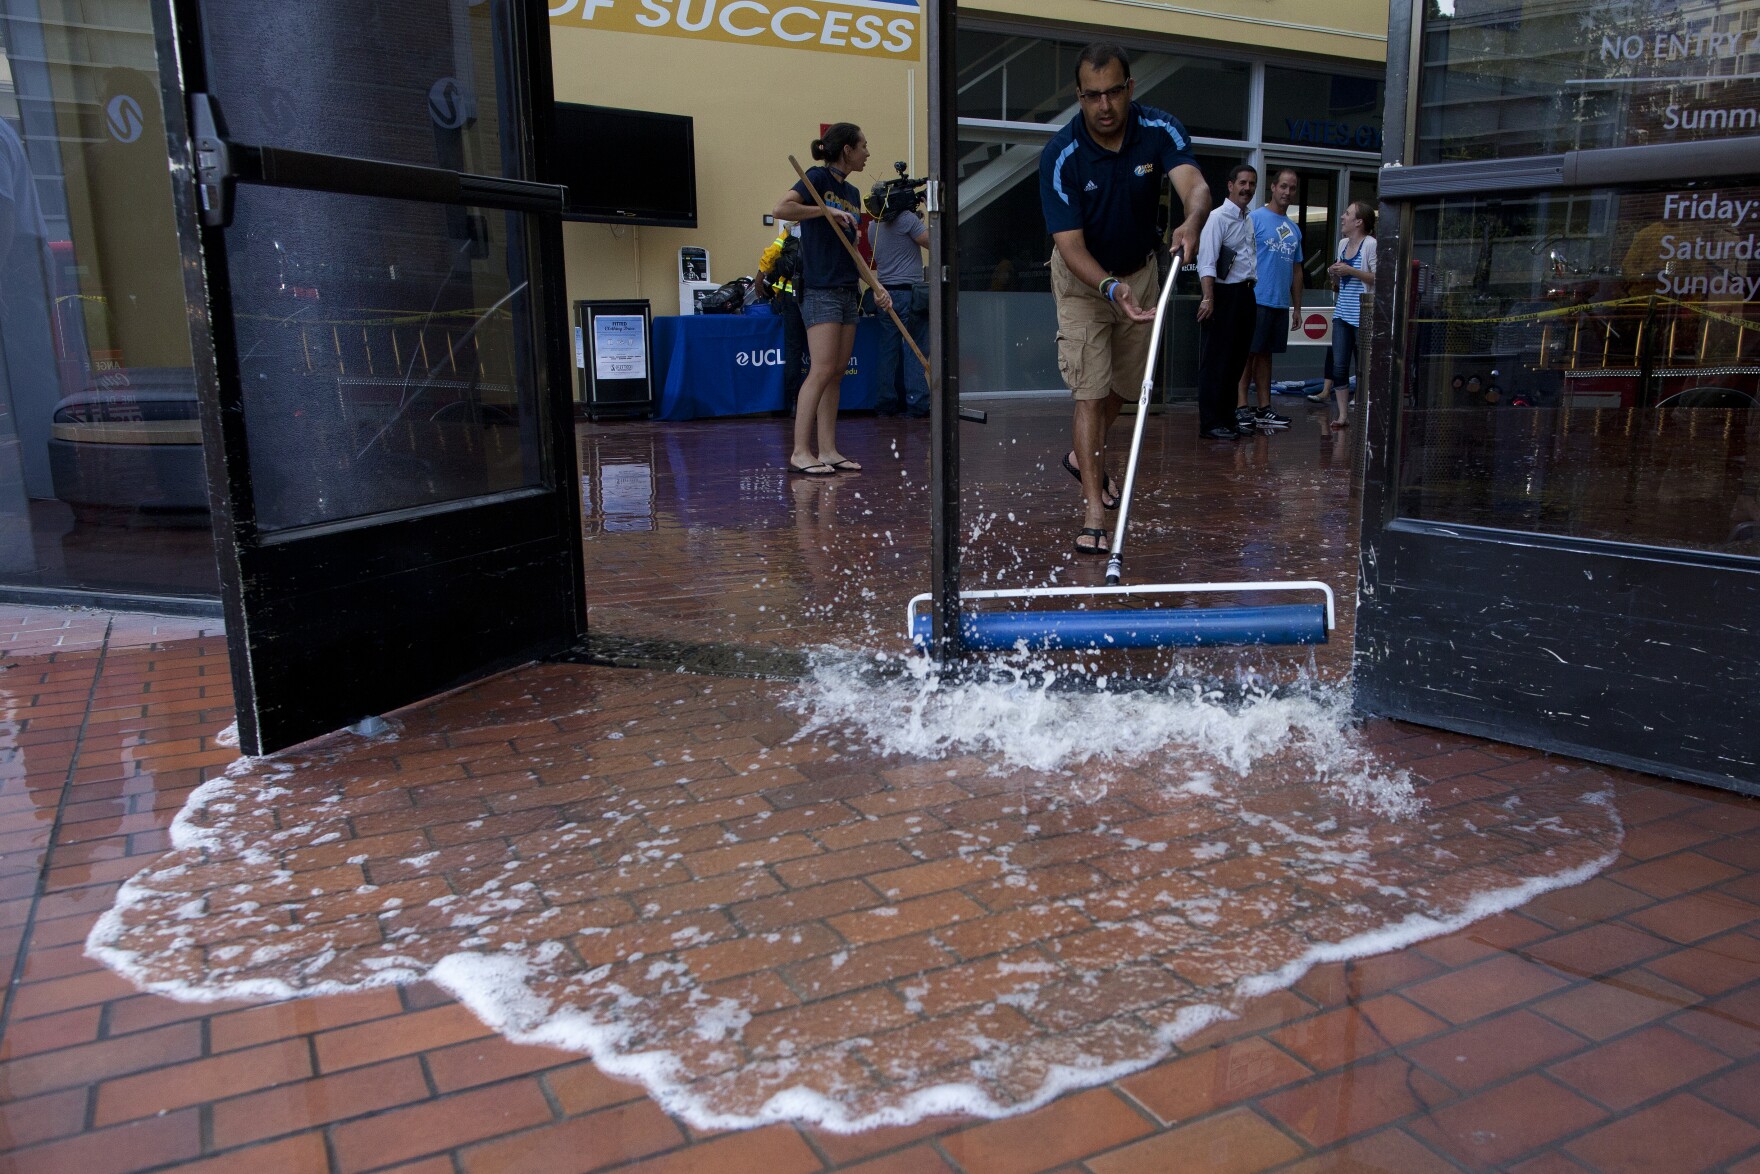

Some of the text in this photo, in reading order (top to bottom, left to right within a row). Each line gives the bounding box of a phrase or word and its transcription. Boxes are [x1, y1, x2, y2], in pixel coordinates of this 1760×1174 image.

[635, 0, 915, 53] SUCCESS
[1600, 35, 1644, 60] NO
[1654, 31, 1743, 59] ENTRY
[1663, 104, 1760, 130] Summ
[1285, 117, 1383, 148] YATES GY
[1663, 192, 1760, 227] Friday:
[751, 348, 787, 367] UCL
